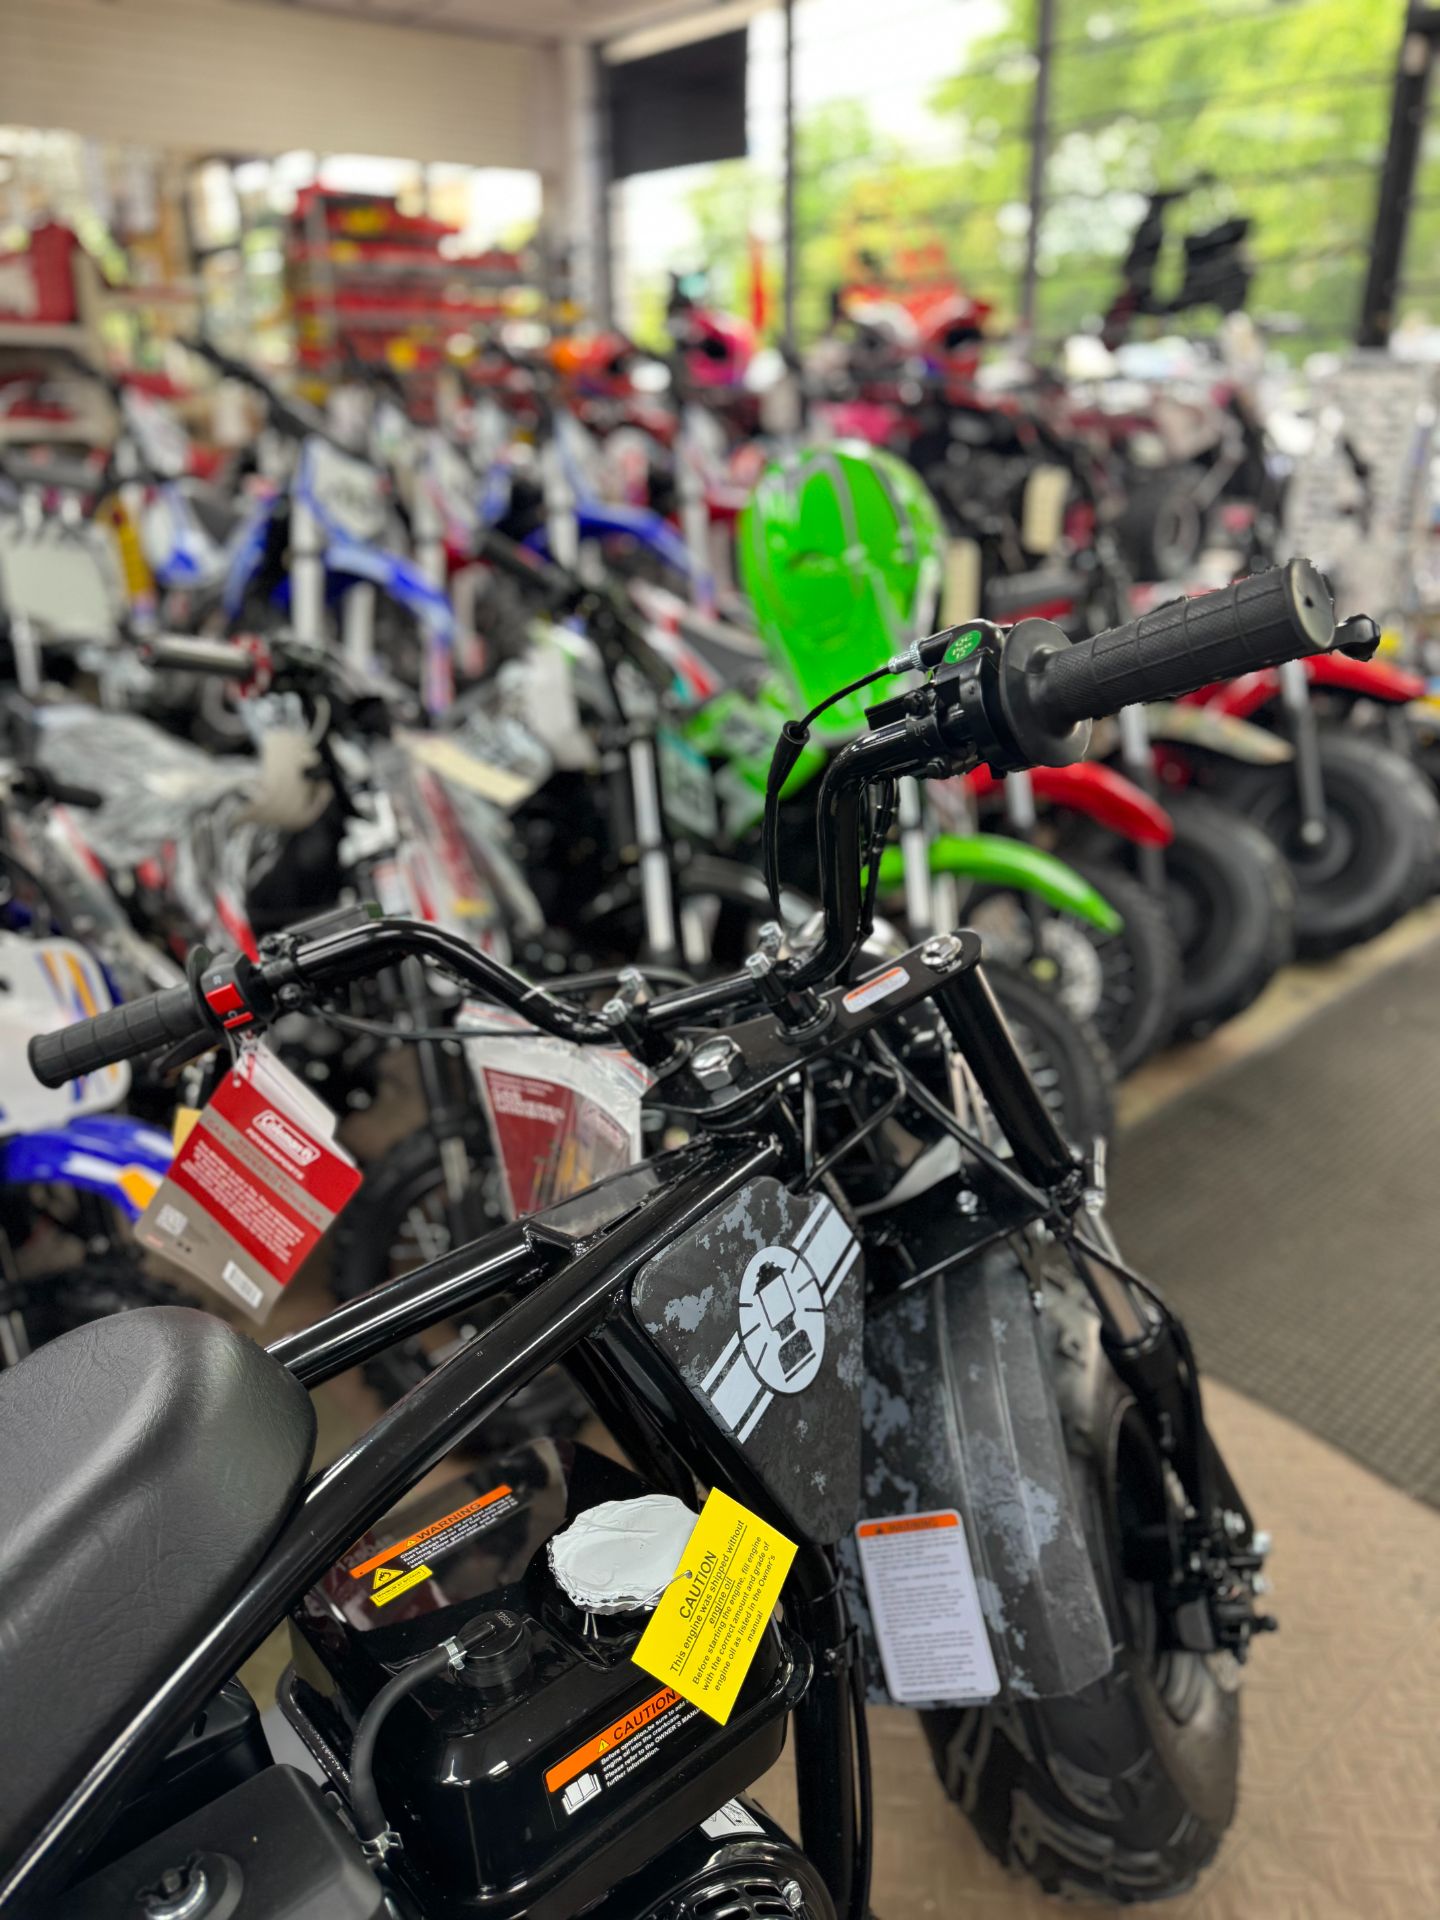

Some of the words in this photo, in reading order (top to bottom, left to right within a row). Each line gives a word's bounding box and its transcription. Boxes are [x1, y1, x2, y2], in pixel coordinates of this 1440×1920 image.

[261, 1113, 306, 1163] Coleman
[417, 1503, 482, 1539] WARNING
[400, 1547, 419, 1558] Check
[670, 1651, 686, 1671] This
[684, 1615, 702, 1649] engine
[700, 1594, 712, 1613] was
[710, 1554, 729, 1592] shipped
[726, 1520, 744, 1553] without
[680, 1551, 716, 1618] CAUTION
[709, 1592, 726, 1624] engine
[721, 1574, 732, 1590] oil
[692, 1655, 710, 1684] Before
[708, 1618, 726, 1654] starting
[720, 1603, 731, 1619] the
[742, 1563, 750, 1574] fill
[748, 1537, 761, 1563] engine
[703, 1672, 714, 1690] with
[711, 1656, 721, 1671] the
[720, 1624, 735, 1655] correct
[733, 1592, 749, 1624] amount
[747, 1575, 756, 1591] and
[754, 1553, 765, 1576] grade
[764, 1541, 769, 1551] of
[715, 1661, 730, 1691] engine
[734, 1637, 741, 1647] as
[738, 1611, 751, 1635] listed
[748, 1603, 756, 1611] in
[753, 1588, 761, 1601] the
[759, 1555, 775, 1587] Owner's
[747, 1610, 763, 1642] manual
[601, 1749, 620, 1765] Before
[655, 1715, 667, 1725] sure
[675, 1701, 685, 1711] add
[614, 1690, 676, 1741] CAUTION
[603, 1756, 622, 1772] engine
[631, 1741, 642, 1751] into
[642, 1734, 652, 1743] the
[605, 1764, 624, 1780] Please
[624, 1753, 637, 1765] refer
[645, 1742, 654, 1750] the
[655, 1721, 681, 1743] OWNER'S
[607, 1771, 625, 1787] further
[627, 1747, 659, 1772] information.
